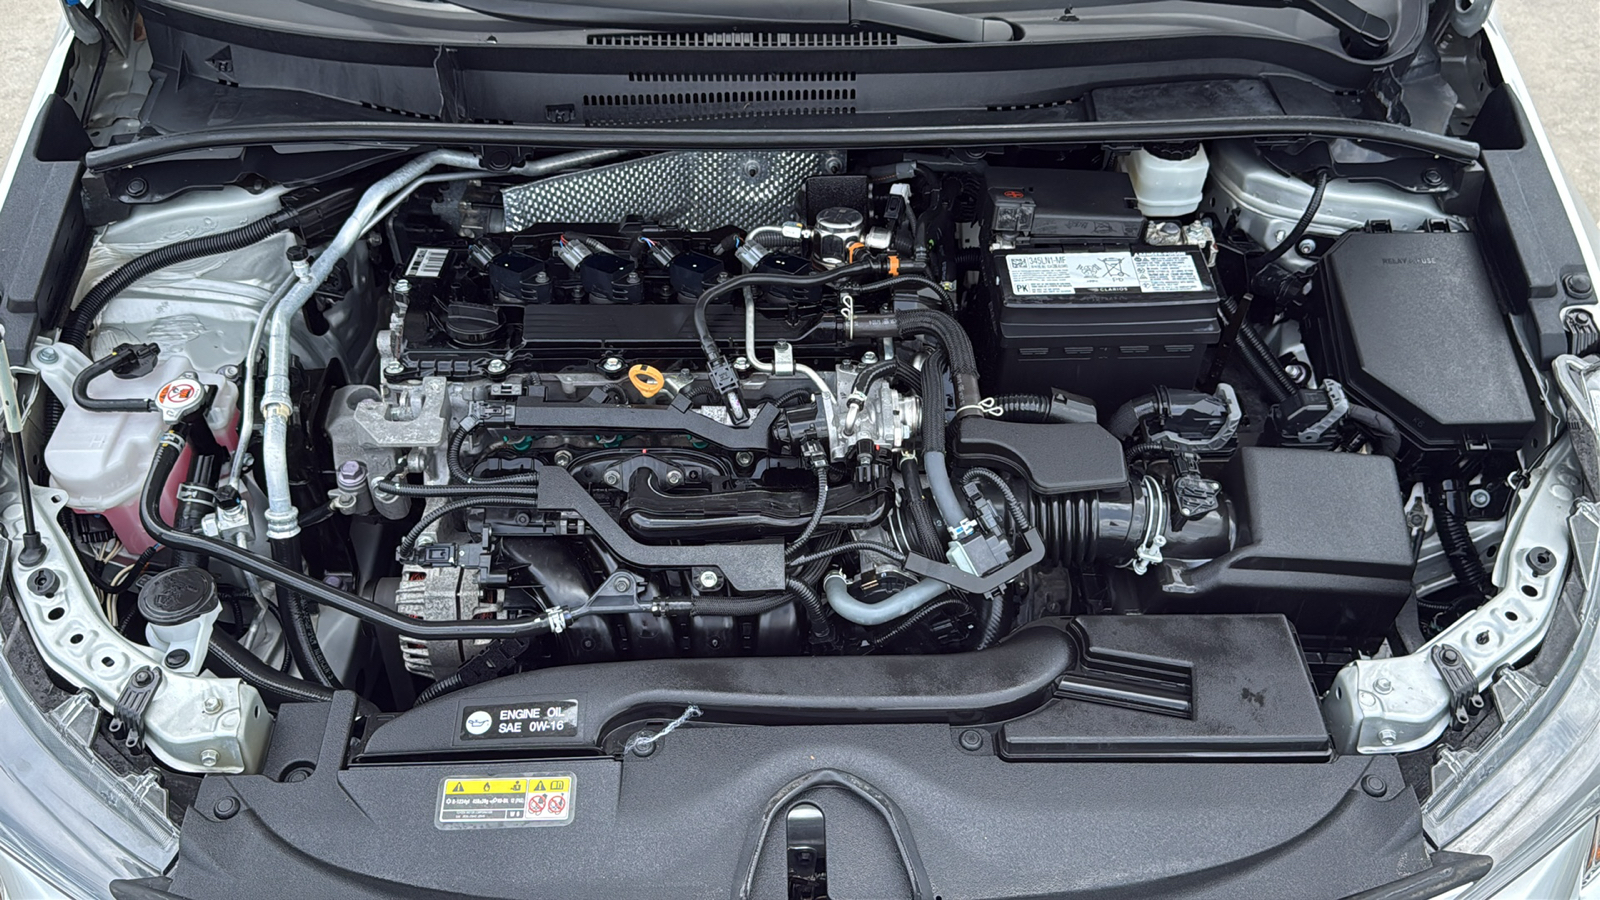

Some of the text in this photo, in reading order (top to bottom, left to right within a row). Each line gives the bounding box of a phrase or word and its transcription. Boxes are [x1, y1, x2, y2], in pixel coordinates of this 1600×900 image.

[1017, 284, 1029, 292] PK
[499, 706, 565, 720] ENGINE OIL
[498, 720, 564, 734] SAE 0W-16
